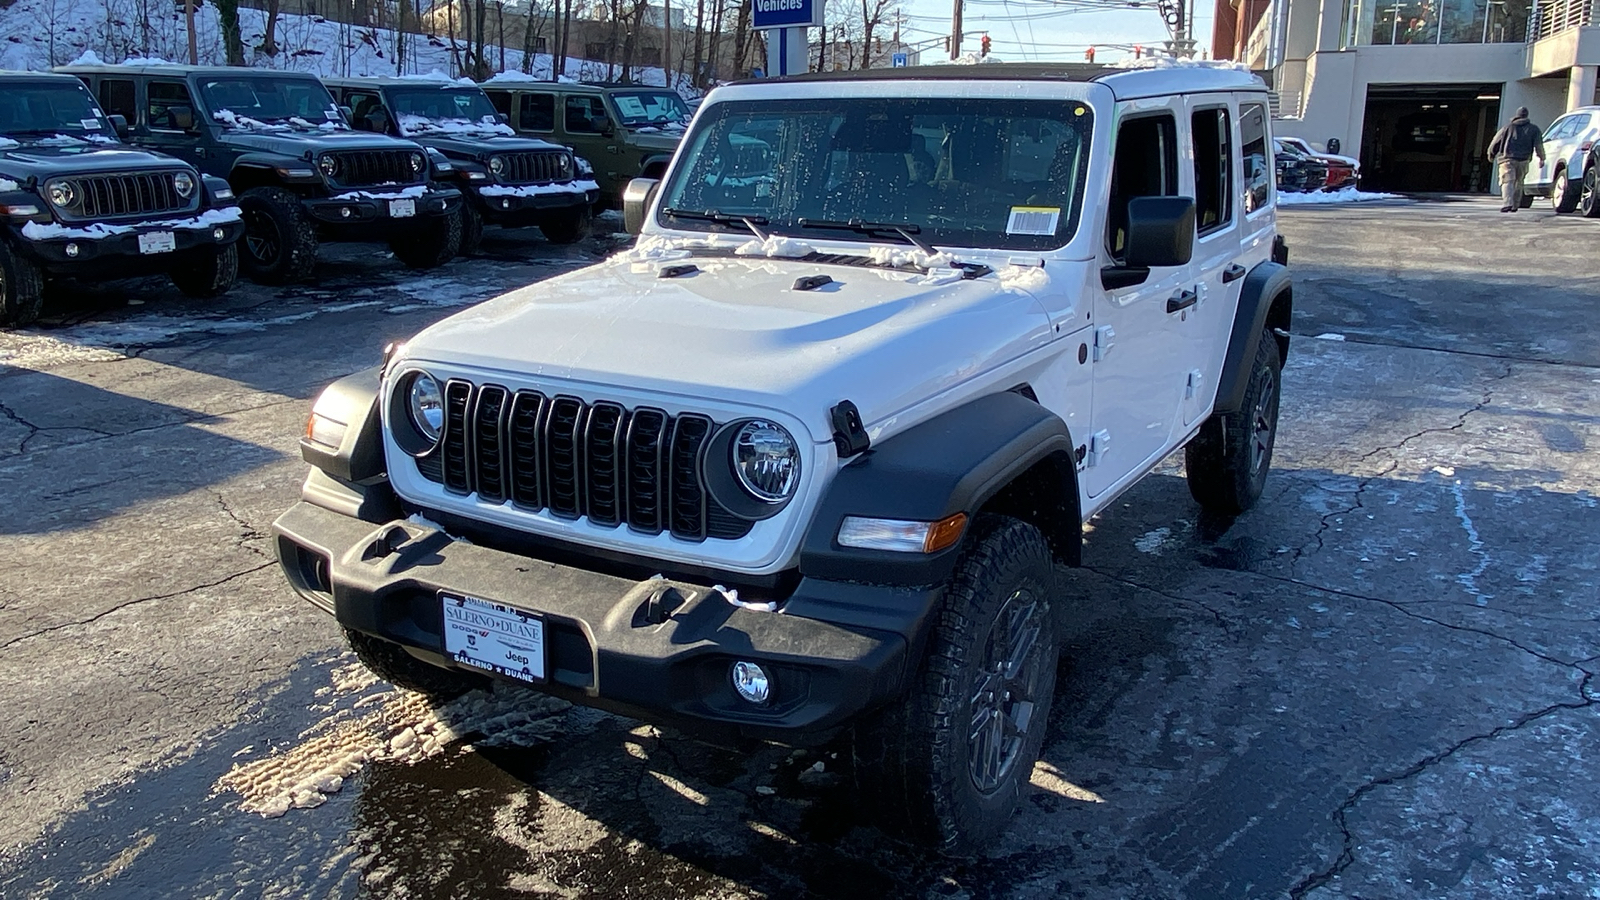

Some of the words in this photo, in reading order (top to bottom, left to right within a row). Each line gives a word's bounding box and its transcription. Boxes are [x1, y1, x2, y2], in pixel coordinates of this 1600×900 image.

[757, 0, 803, 12] Vehicles
[446, 607, 495, 628] SALERNO
[500, 619, 540, 640] DUANE
[454, 654, 493, 671] SALERNO
[505, 668, 534, 683] DUANE
[505, 650, 529, 666] Jeep
